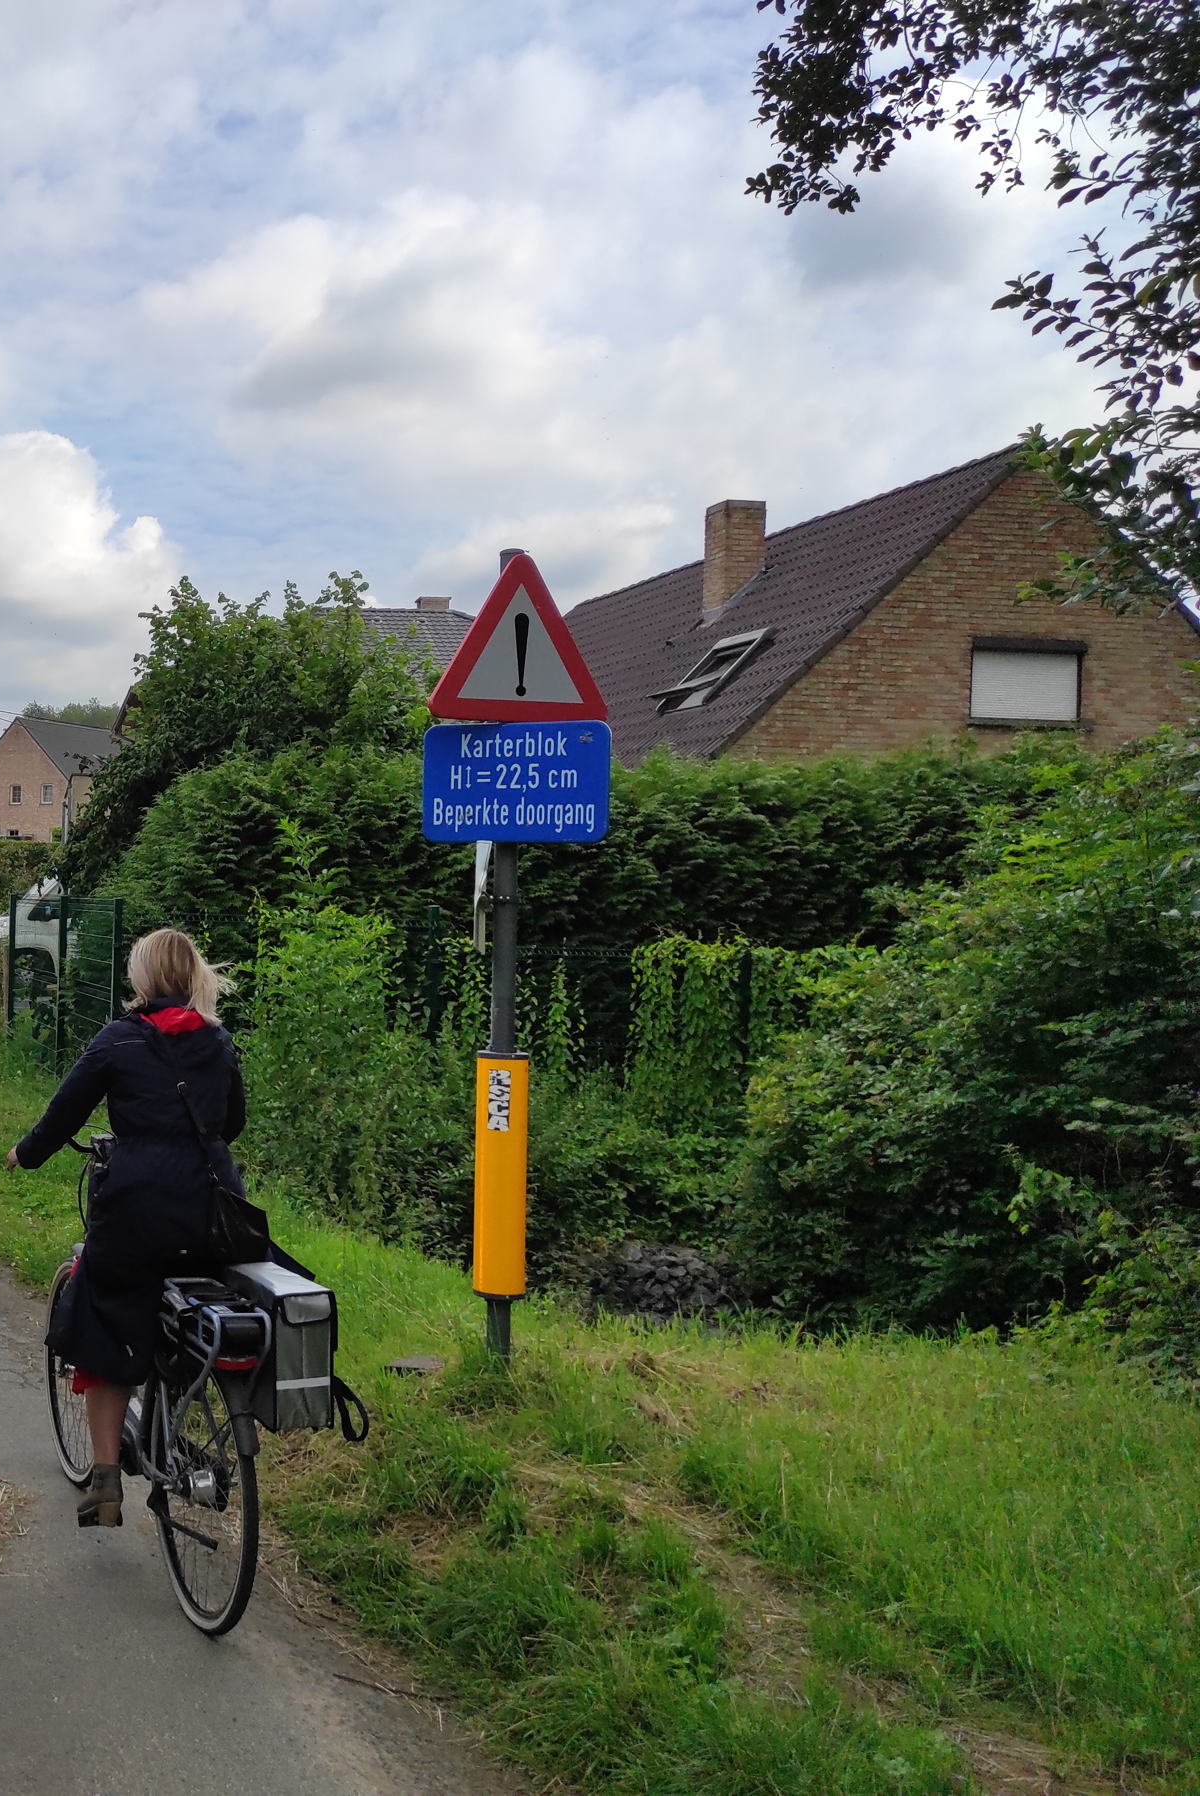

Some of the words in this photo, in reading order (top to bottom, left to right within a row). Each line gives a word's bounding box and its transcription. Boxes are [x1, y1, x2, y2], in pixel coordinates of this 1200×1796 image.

[460, 731, 568, 758] Karterblok
[548, 768, 578, 788] cm
[433, 797, 509, 833] Beperkte
[515, 797, 596, 833] doorgang
